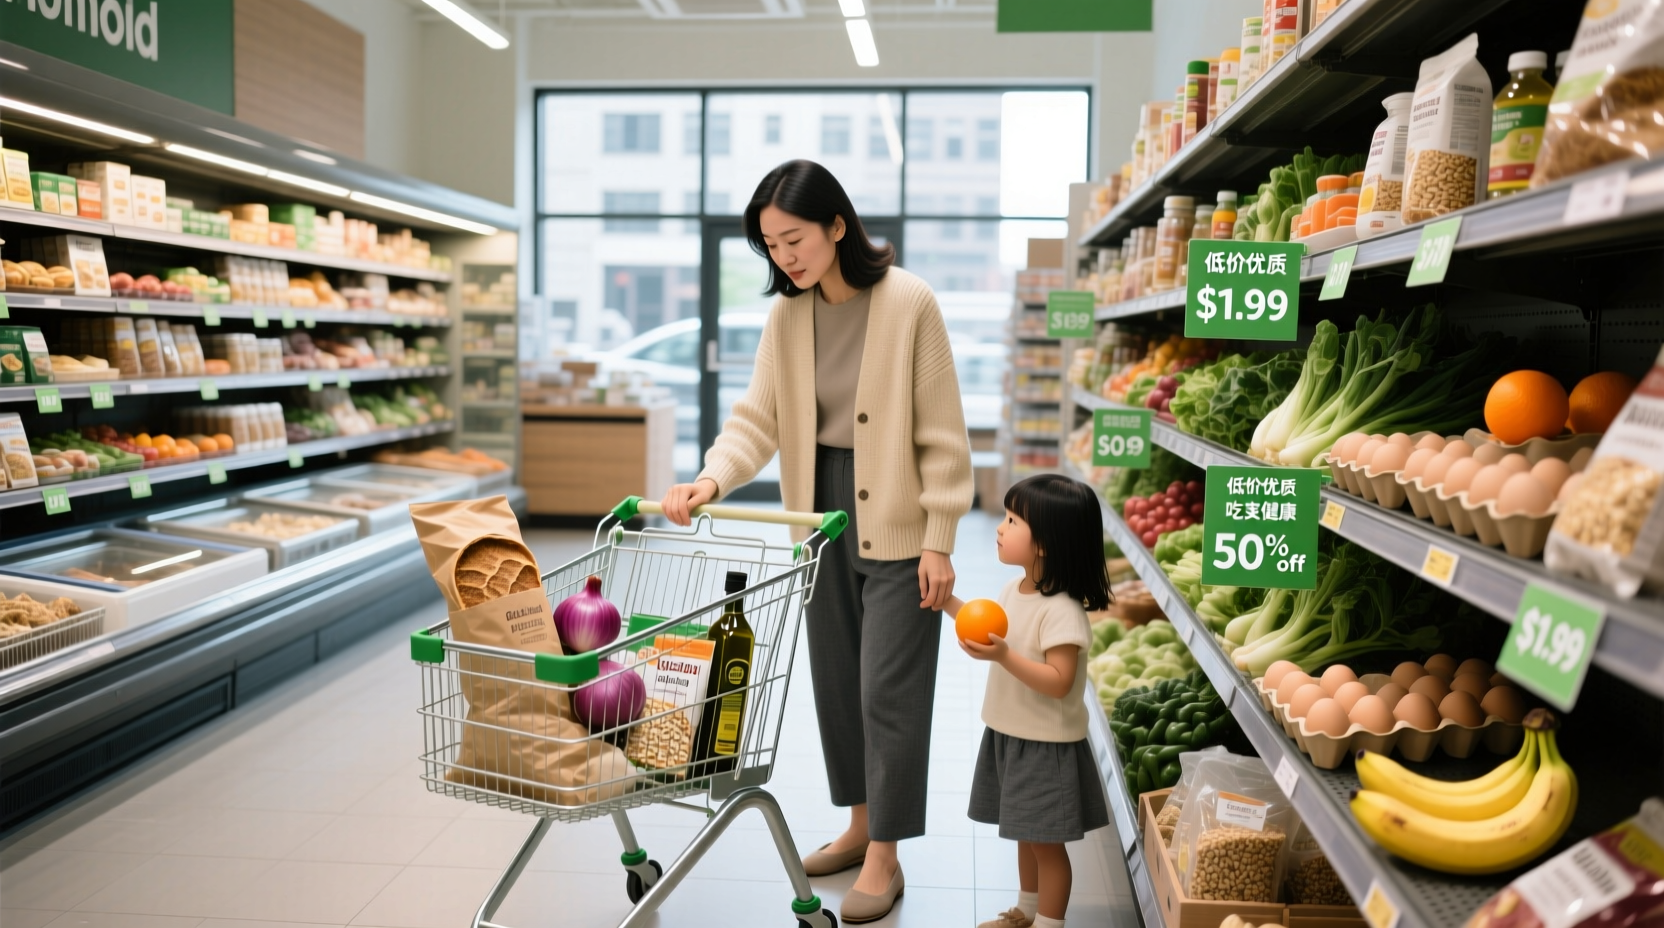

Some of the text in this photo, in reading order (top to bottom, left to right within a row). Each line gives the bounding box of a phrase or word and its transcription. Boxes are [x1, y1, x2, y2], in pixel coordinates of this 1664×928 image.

[1204, 251, 1287, 275] 低价优质
[1196, 283, 1288, 324] $1.99
[1226, 476, 1296, 496] 低价优质
[1212, 532, 1306, 573] 50% off
